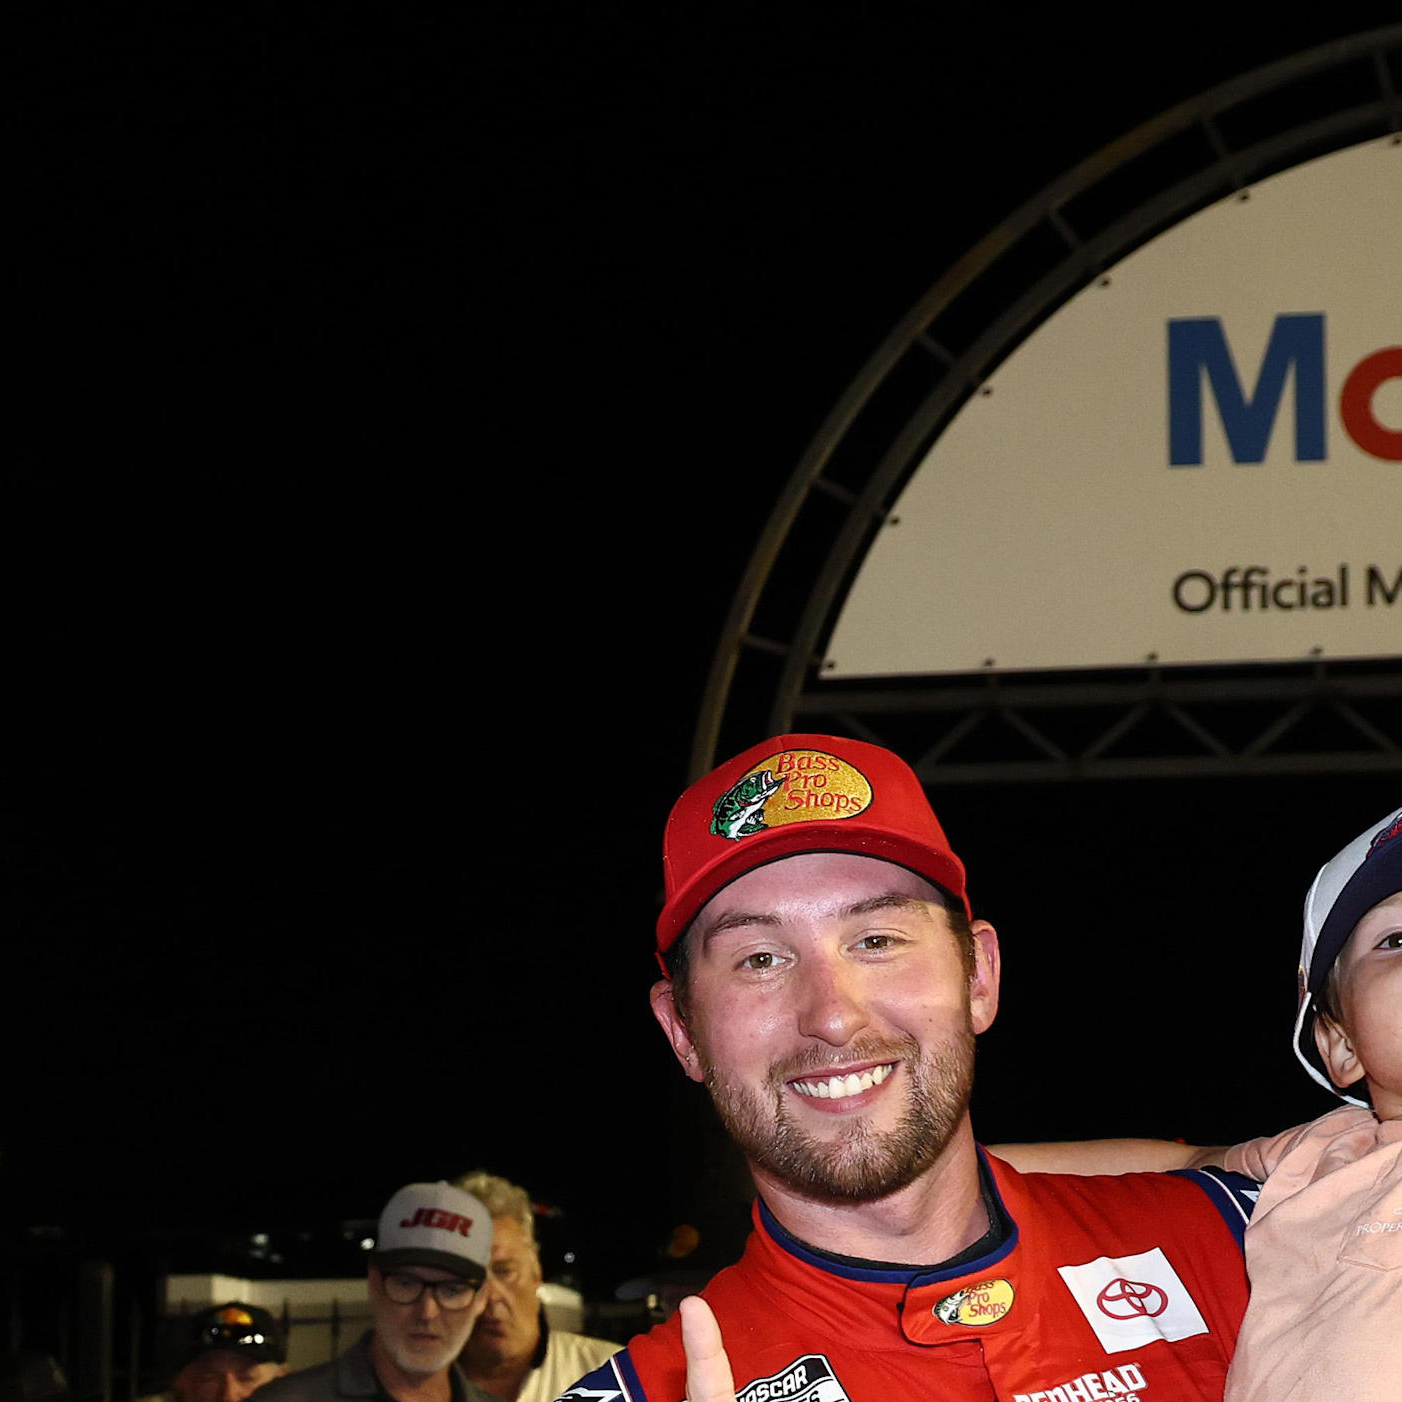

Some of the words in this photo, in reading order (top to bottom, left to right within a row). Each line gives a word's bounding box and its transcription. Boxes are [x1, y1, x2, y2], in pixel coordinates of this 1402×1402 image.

[1171, 563, 1349, 613] Official
[776, 752, 841, 775] Bass
[784, 771, 827, 792] Pro
[784, 788, 863, 813] Shops
[399, 1207, 473, 1237] JGR
[967, 1291, 990, 1305] Pro
[969, 1302, 1006, 1318] Shops
